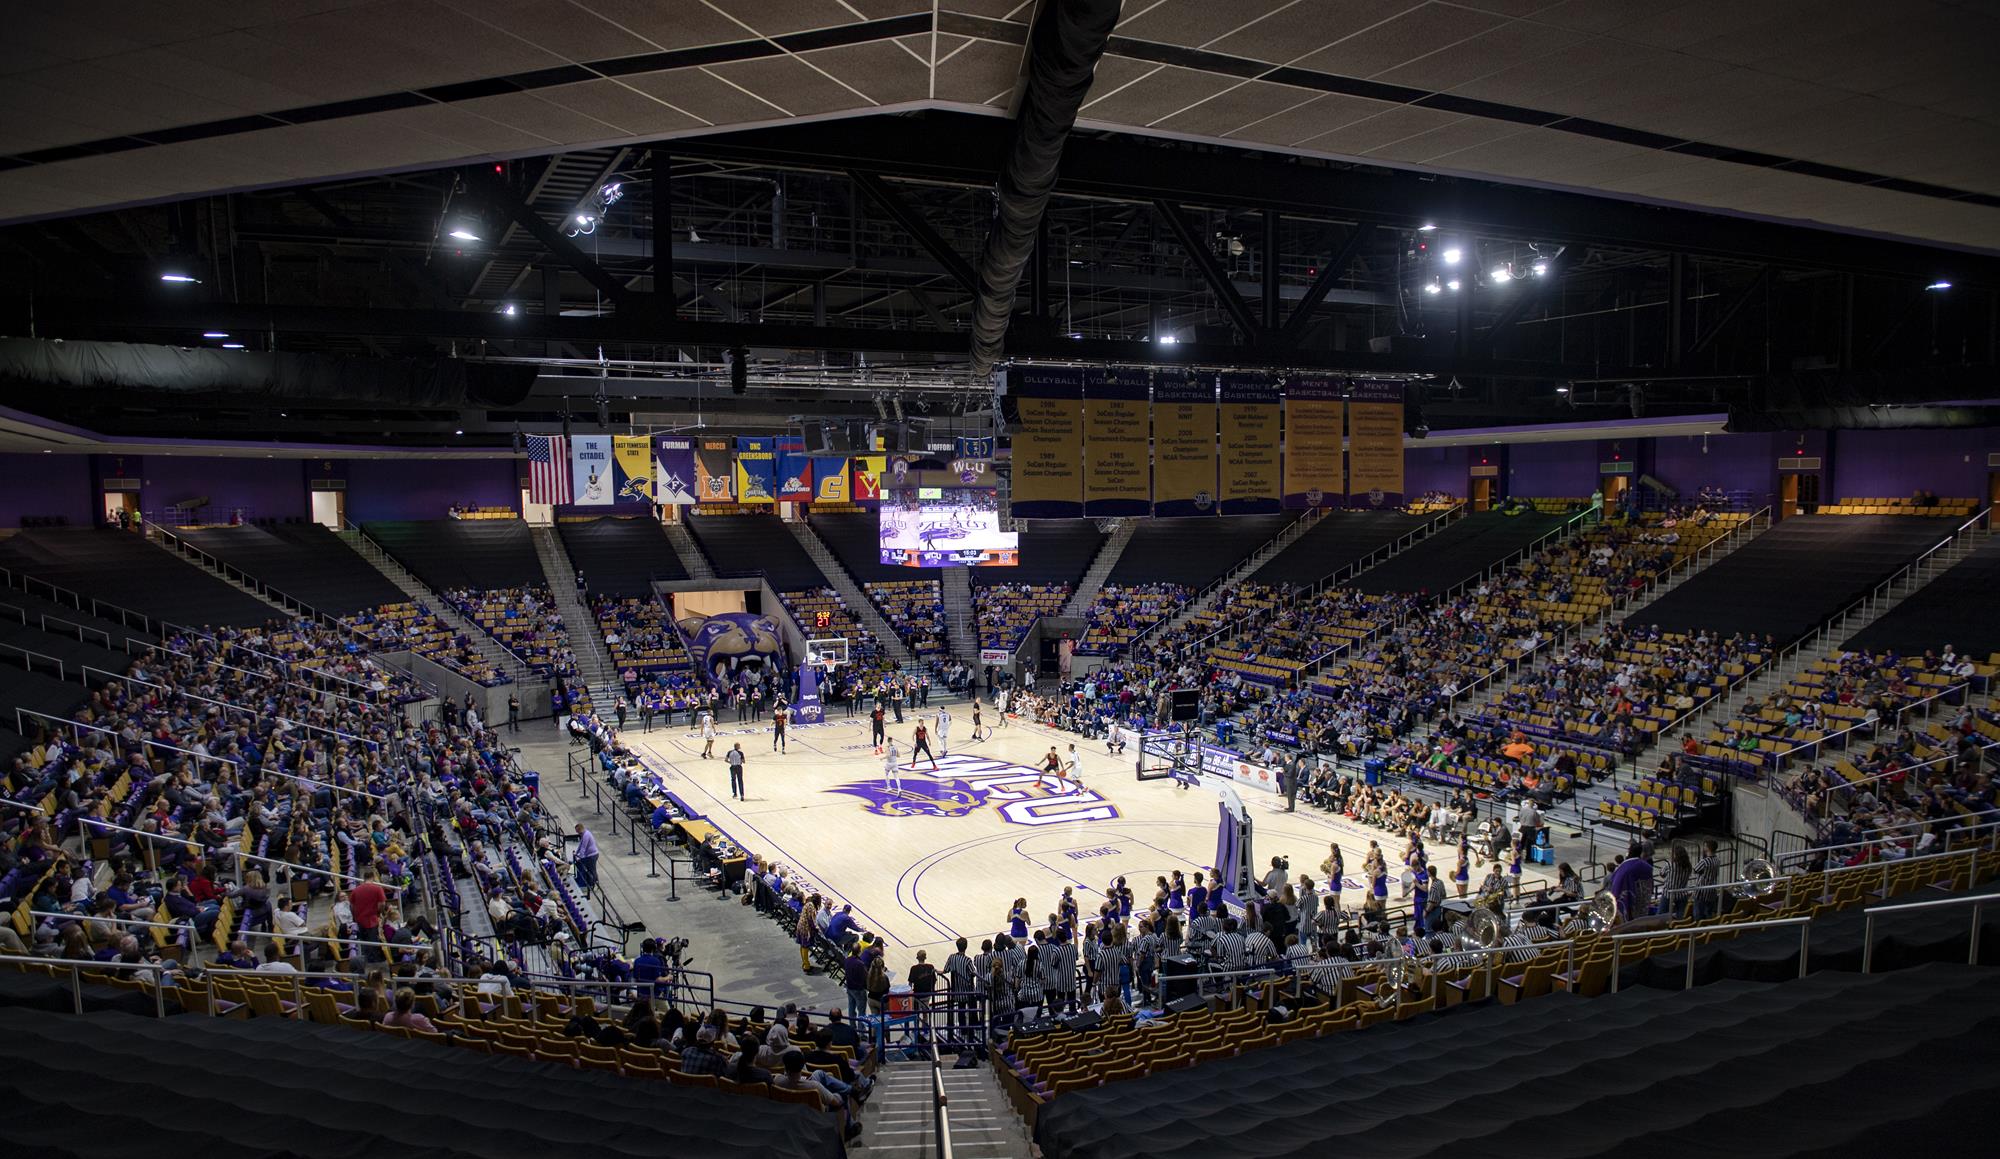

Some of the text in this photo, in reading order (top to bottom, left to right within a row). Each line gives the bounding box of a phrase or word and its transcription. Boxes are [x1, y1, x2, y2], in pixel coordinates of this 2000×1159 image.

[1024, 376, 1078, 385] OLLEYBALL
[1090, 376, 1146, 386] VOLYBALL
[1157, 390, 1212, 399] BASKETBALL
[1224, 391, 1276, 399] BASKETBALL
[1289, 389, 1341, 397] BASKETBALL
[1352, 391, 1401, 399] BASKETBALL
[1797, 434, 1804, 445] J
[586, 442, 598, 450] THE
[662, 441, 690, 450] FURMAN
[705, 442, 726, 450] MERCER
[579, 452, 604, 460] CITADEL
[738, 452, 773, 460] GREENSBORO
[953, 460, 985, 474] WCU
[819, 475, 843, 498] C
[924, 551, 942, 560] WCU
[817, 617, 829, 627] 27
[800, 705, 821, 715] WCU
[897, 754, 1121, 826] WCU
